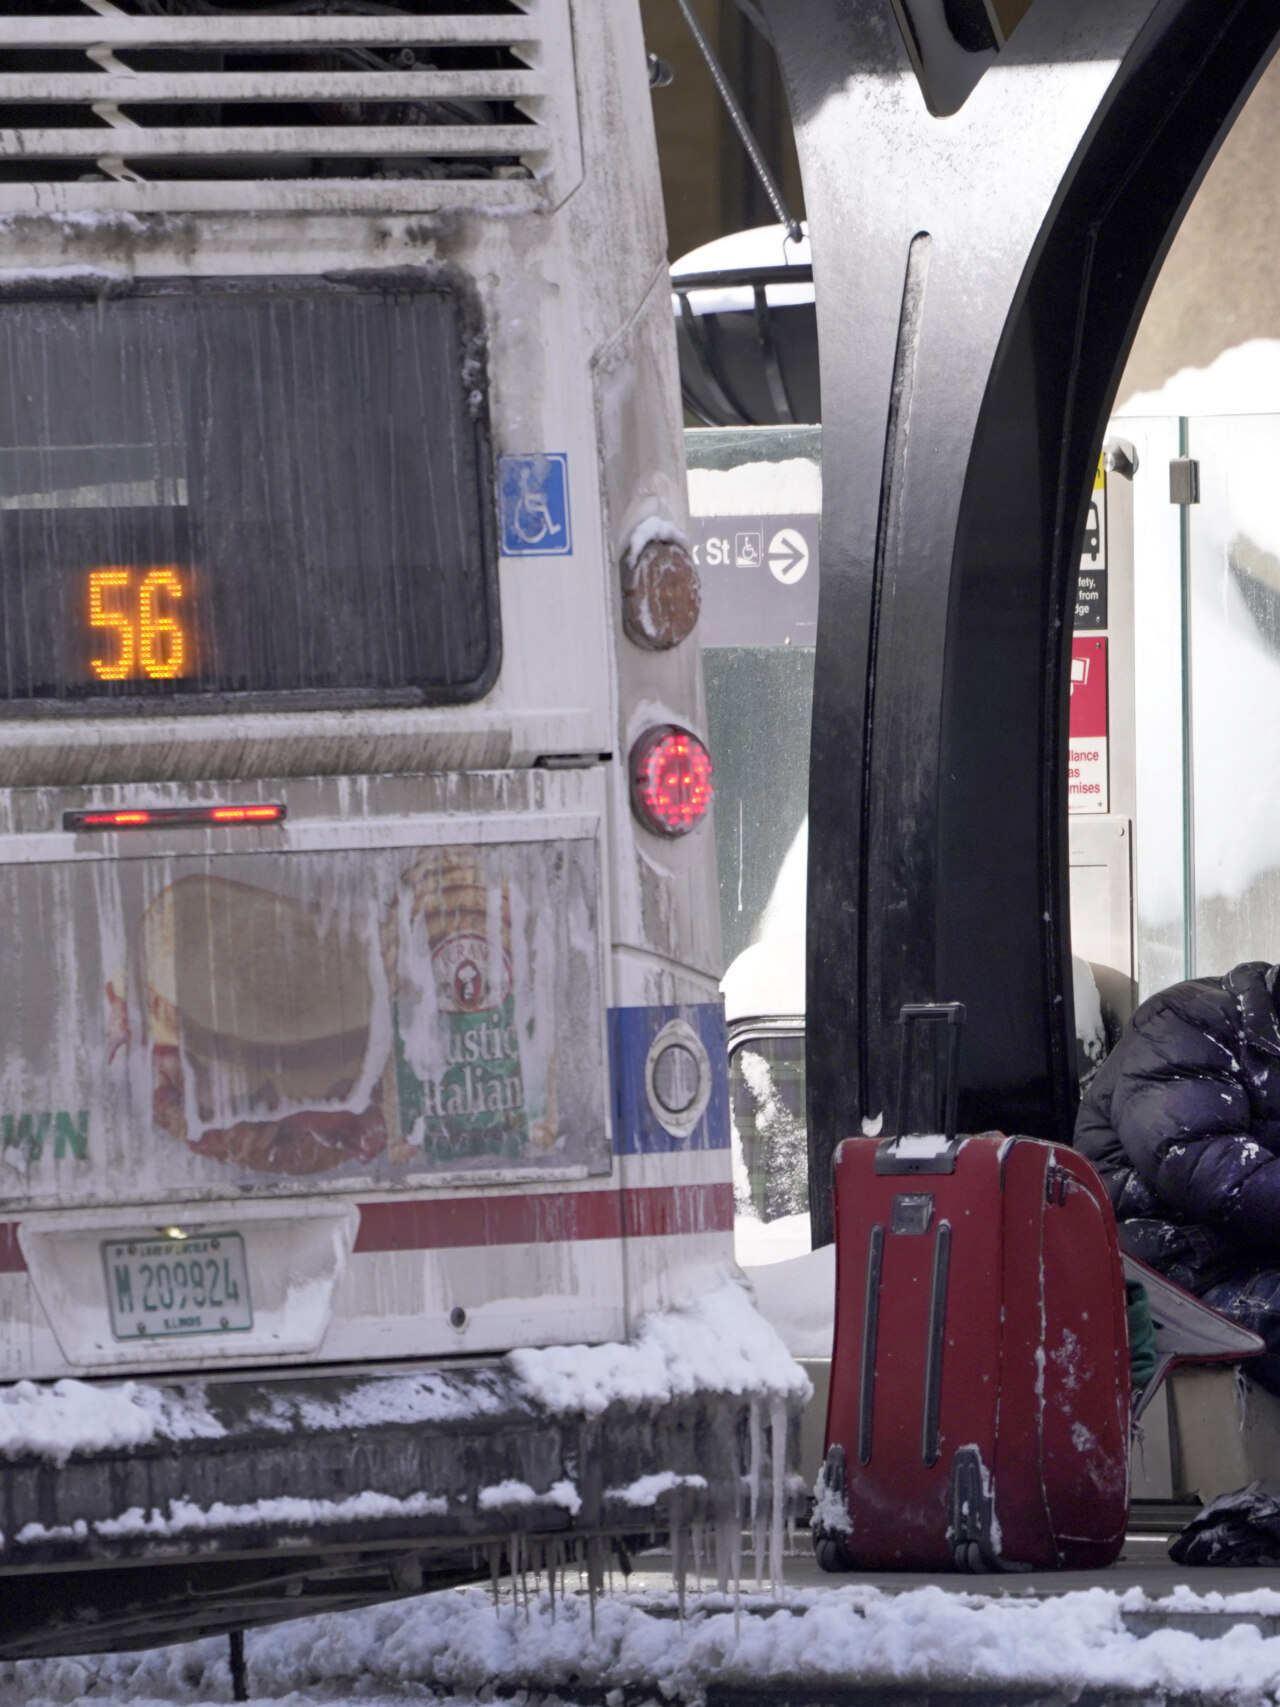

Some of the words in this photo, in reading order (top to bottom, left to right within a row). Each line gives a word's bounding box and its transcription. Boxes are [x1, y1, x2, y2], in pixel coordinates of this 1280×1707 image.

[705, 537, 731, 566] St
[1078, 589, 1099, 601] from
[88, 570, 184, 680] 56
[446, 1013, 518, 1066] ustic
[423, 1066, 524, 1118] Italian
